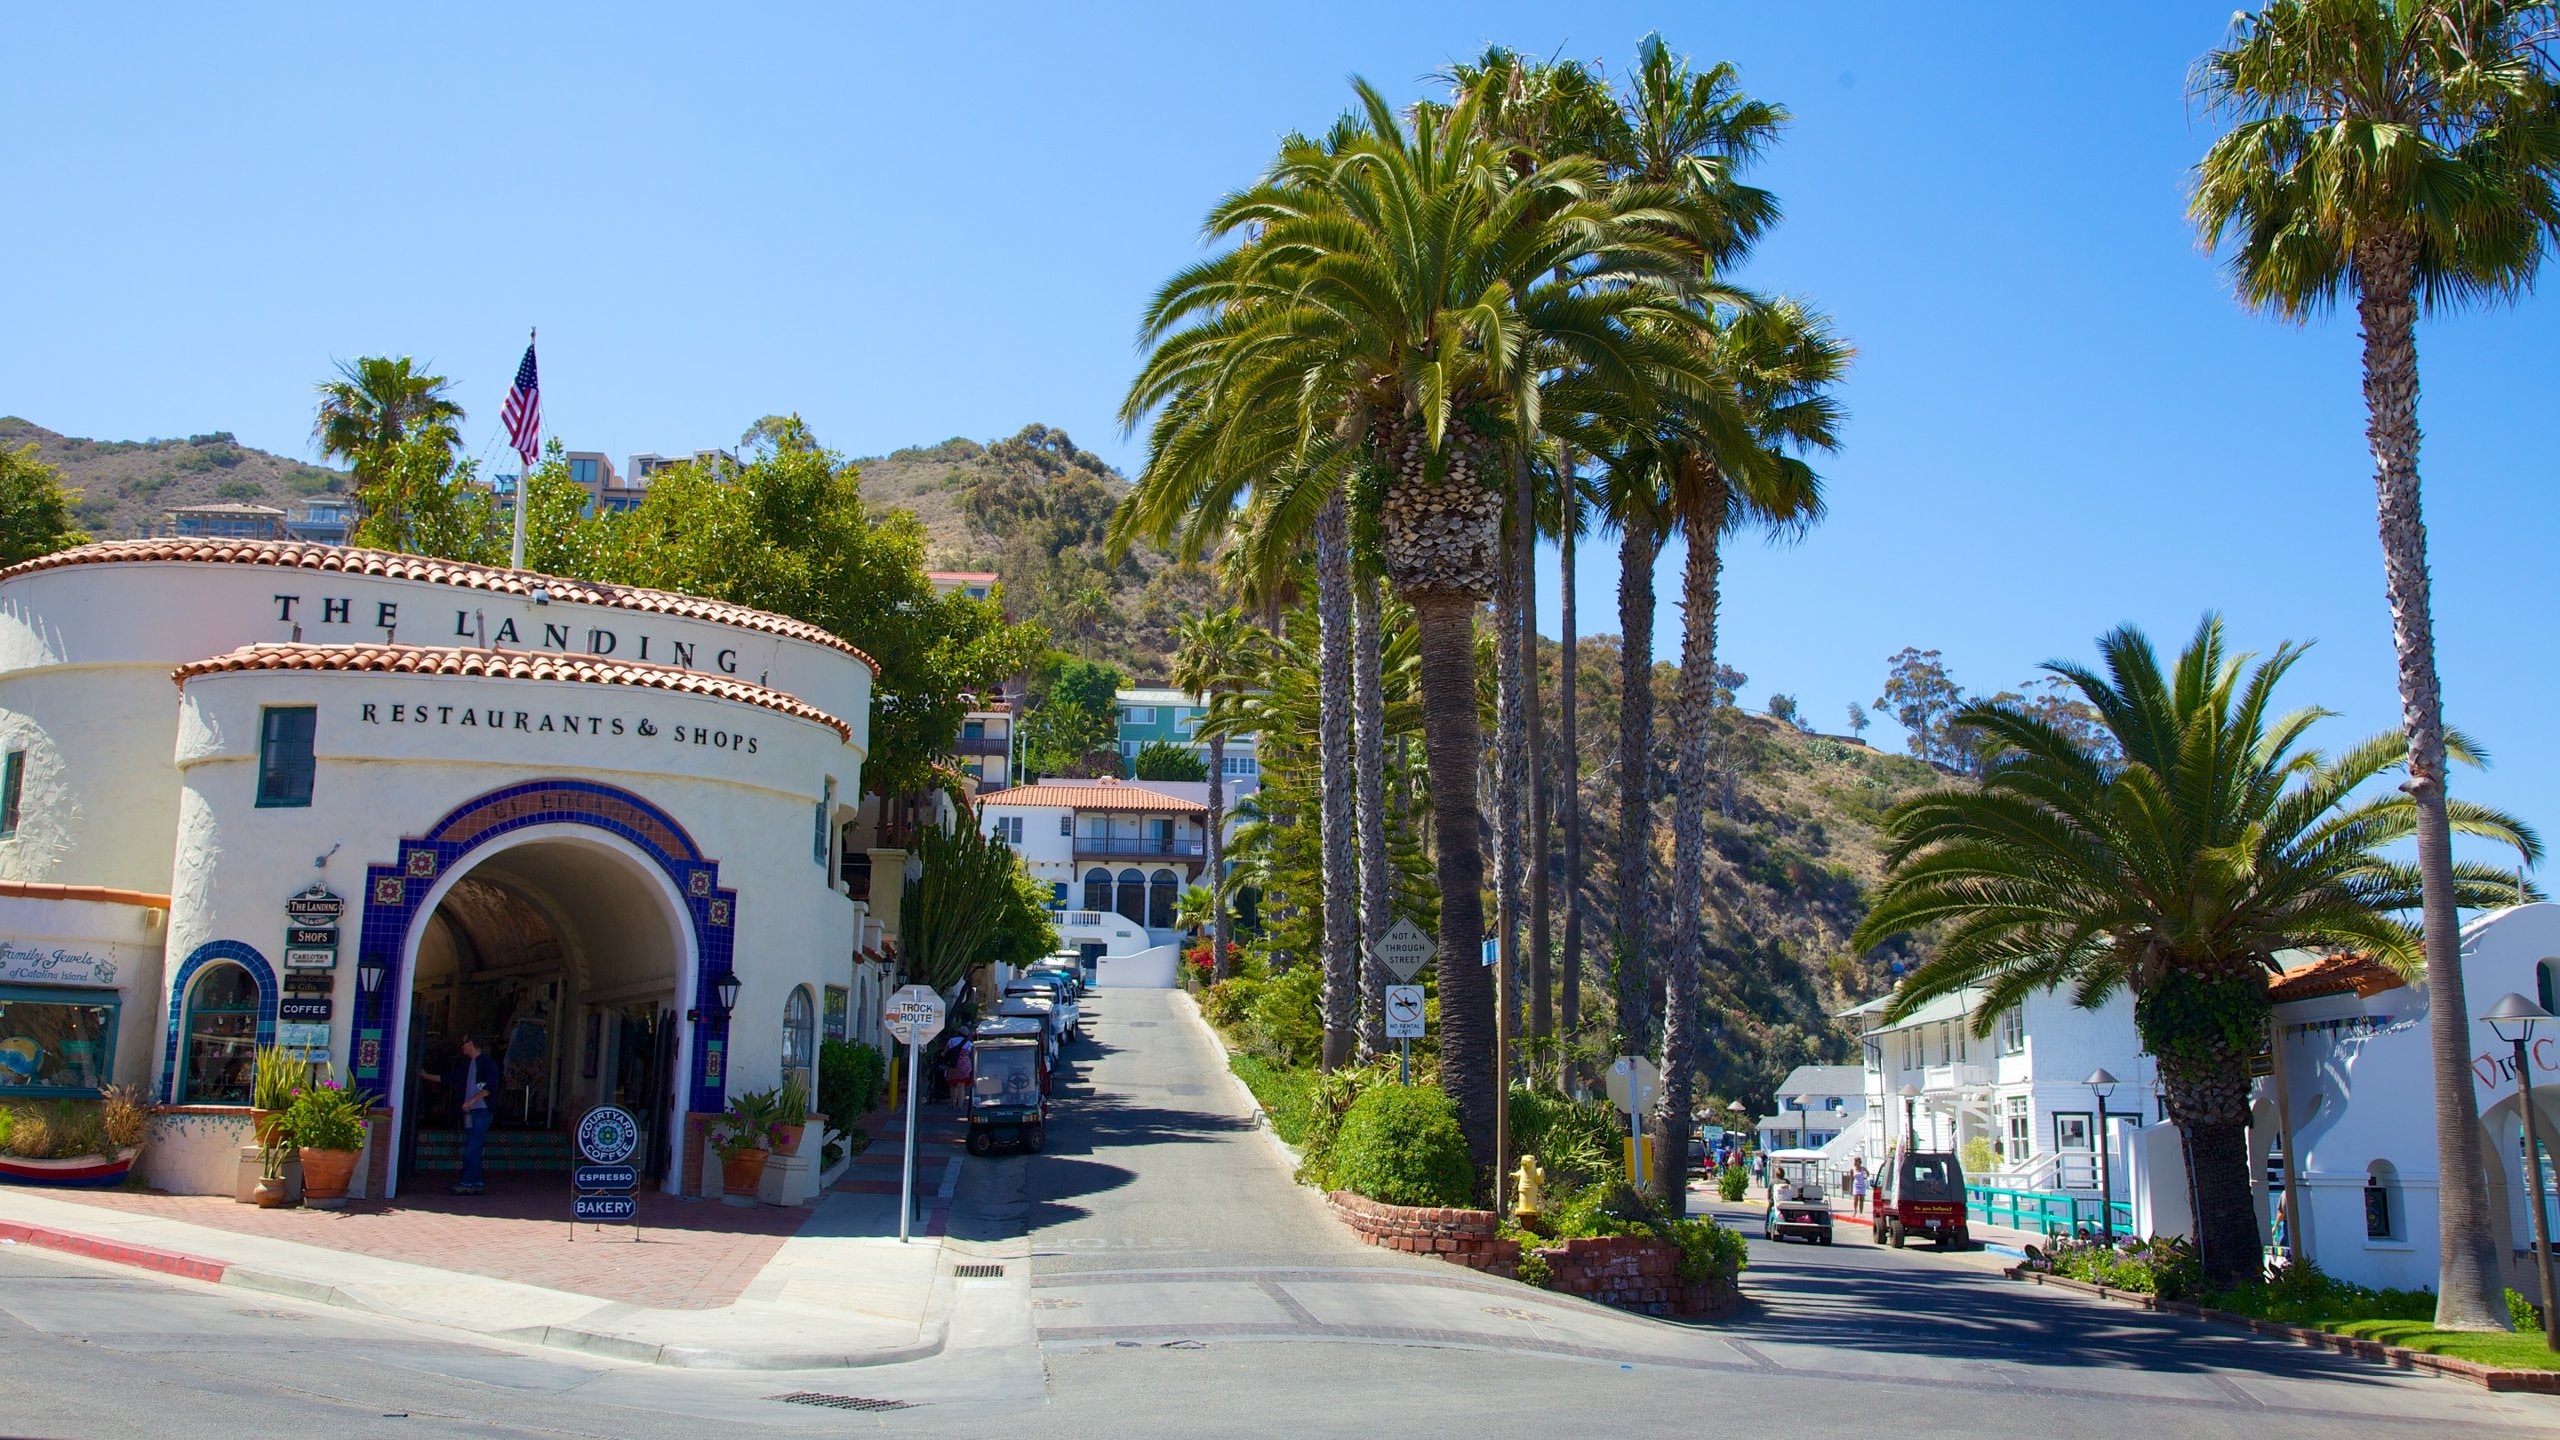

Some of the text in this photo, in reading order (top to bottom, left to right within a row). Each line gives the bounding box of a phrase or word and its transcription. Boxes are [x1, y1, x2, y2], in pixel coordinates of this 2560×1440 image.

[274, 595, 737, 674] THE LANDING
[362, 704, 759, 754] RESTAURANTS & SHOPS
[291, 901, 338, 912] THE LANDING
[298, 930, 328, 942] SHOPS
[1392, 932, 1417, 940] NOT A
[1385, 944, 1425, 952] THROUGH
[42, 949, 95, 969] Jewels
[1389, 956, 1421, 964] STREET
[9, 968, 21, 979] of
[20, 968, 58, 980] Catalina
[283, 1004, 327, 1014] COFFEE
[901, 1003, 933, 1013] TRUCK
[900, 1013, 932, 1023] ROUTE
[582, 1111, 634, 1139] COURTYARD
[585, 1142, 631, 1160] COFFEE
[579, 1173, 632, 1181] ESPRESSO
[576, 1201, 632, 1213] BAKERY
